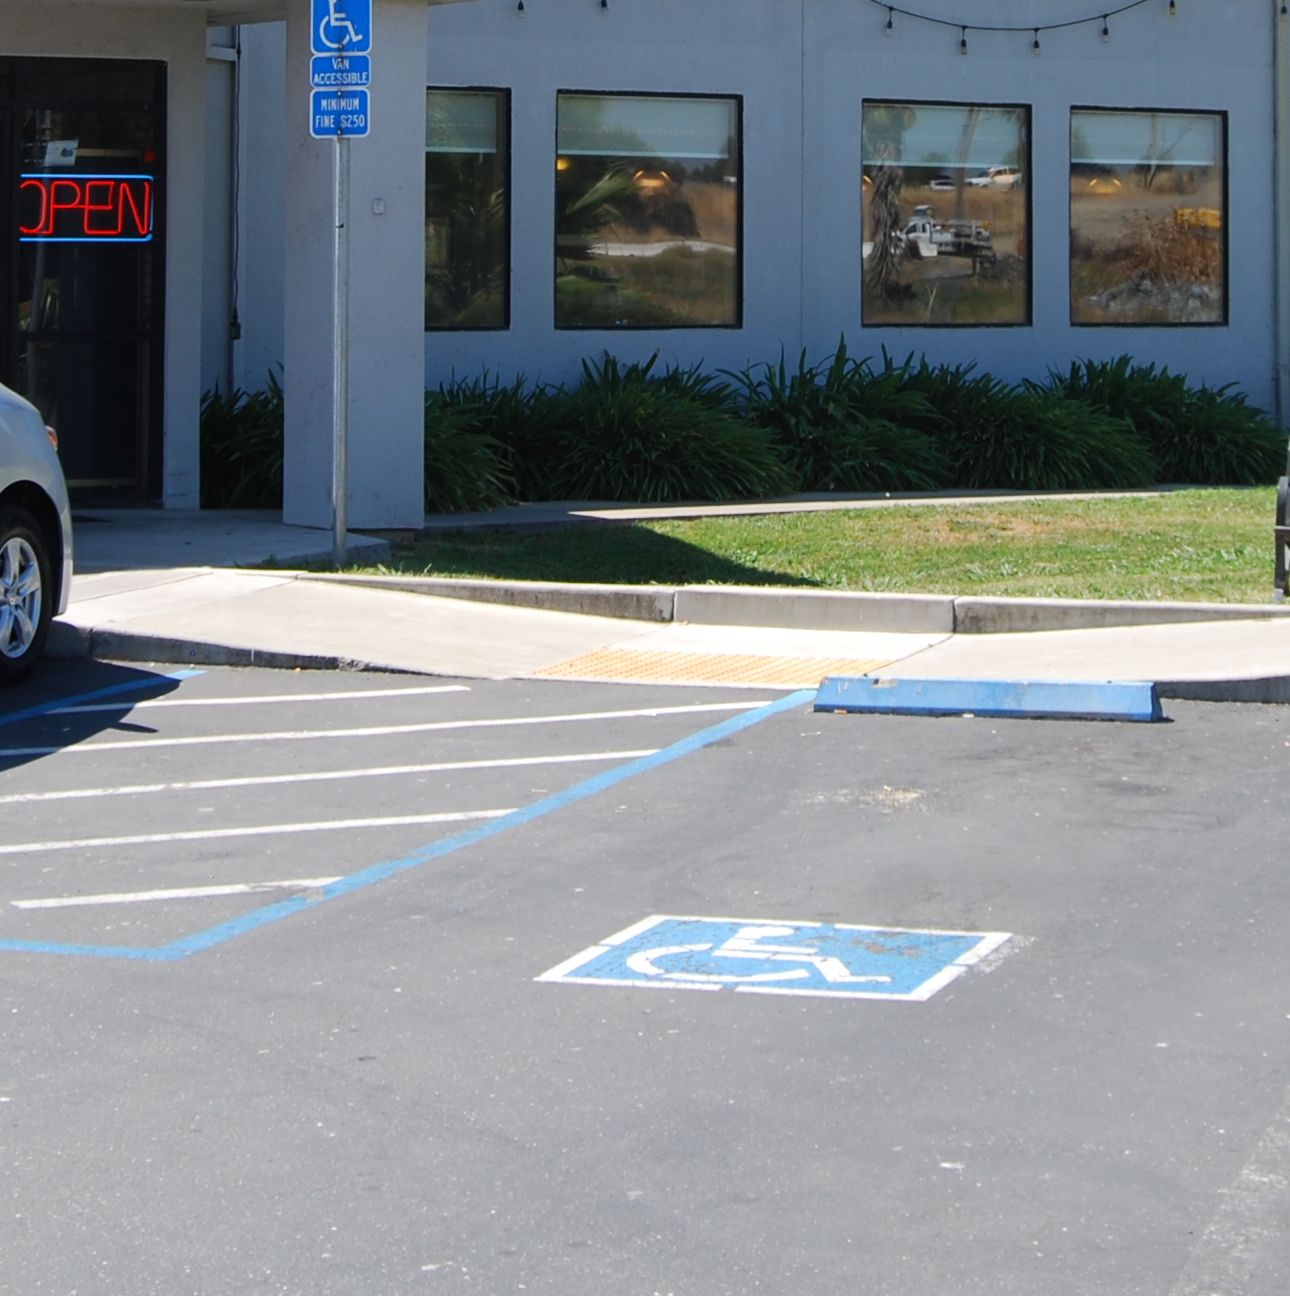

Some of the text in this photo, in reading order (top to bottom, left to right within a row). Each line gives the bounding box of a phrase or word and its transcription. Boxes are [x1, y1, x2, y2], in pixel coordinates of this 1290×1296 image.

[331, 57, 350, 70] VAN
[313, 72, 368, 84] ACCESSIBLE
[320, 98, 360, 111] MINIMUM
[315, 114, 365, 128] FINE $250
